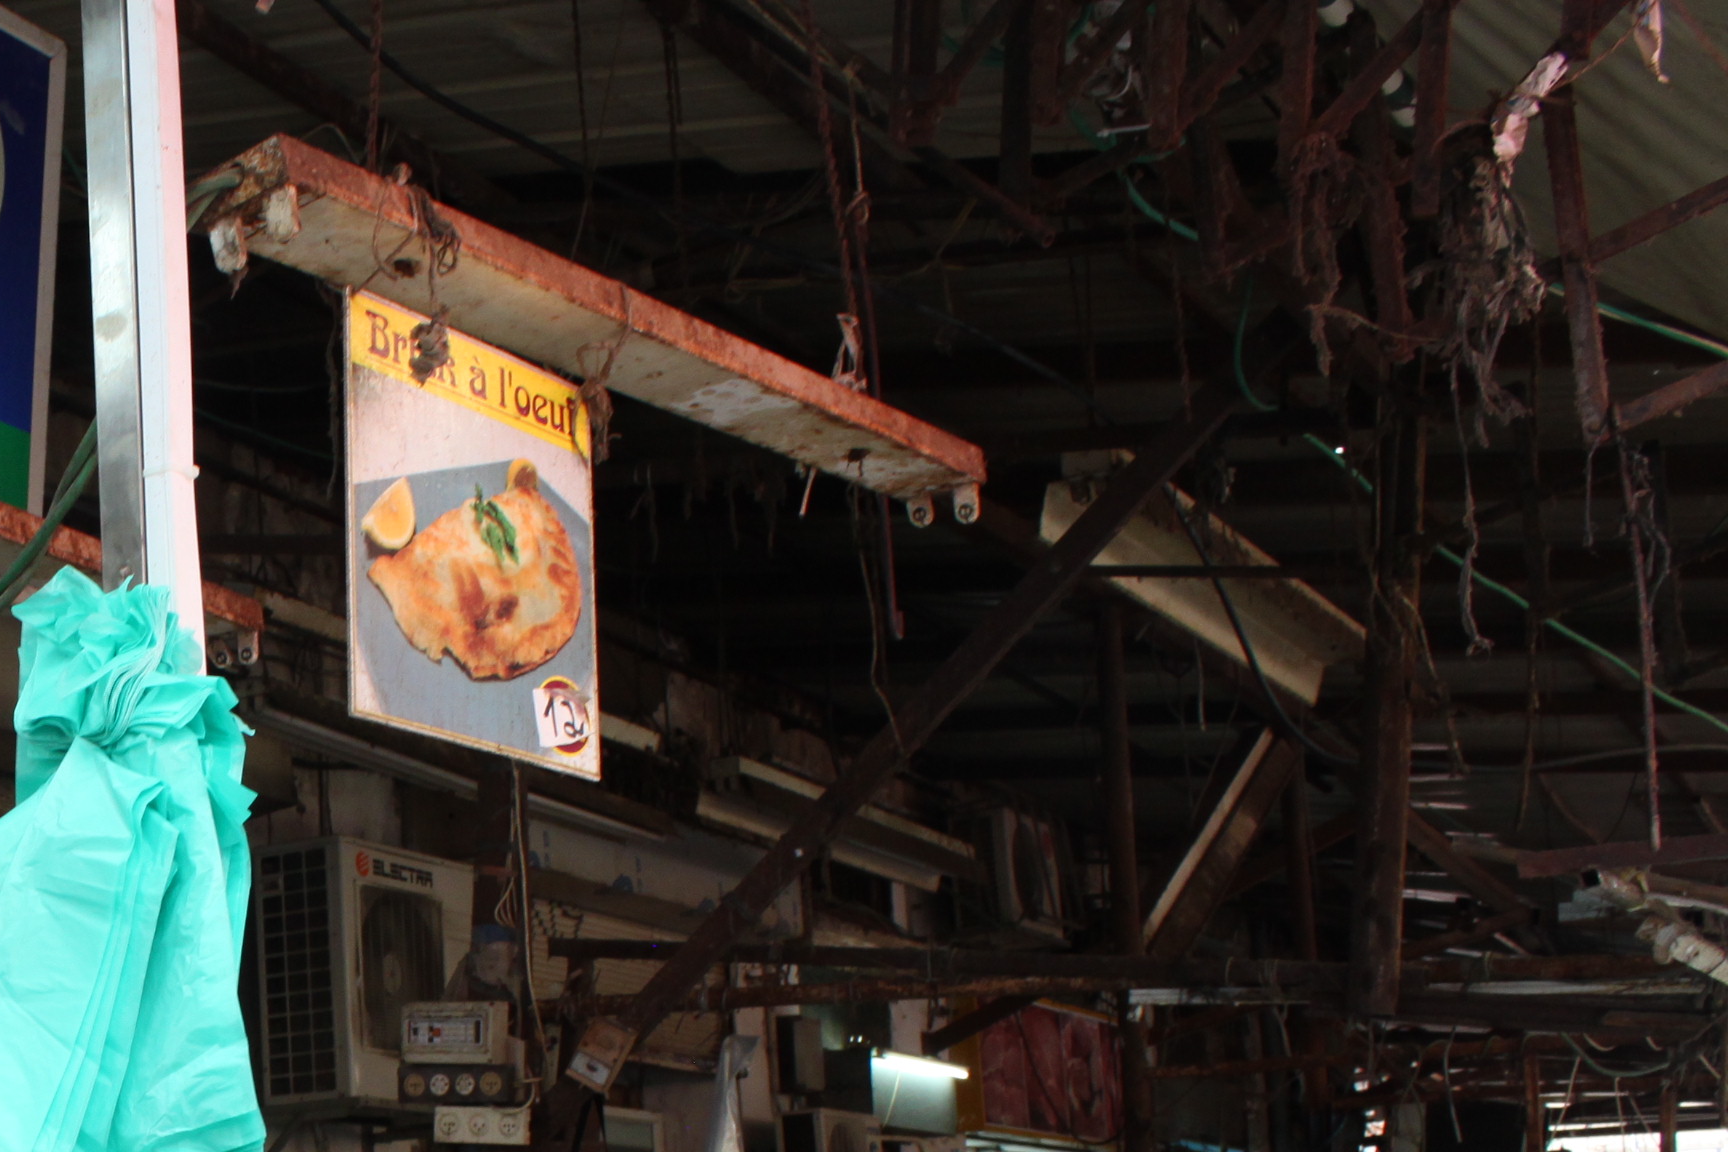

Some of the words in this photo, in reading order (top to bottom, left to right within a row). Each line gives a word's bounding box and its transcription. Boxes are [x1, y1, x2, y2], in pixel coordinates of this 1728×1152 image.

[469, 356, 488, 401] à
[543, 694, 585, 738] 12
[372, 859, 433, 889] ELECTRA
